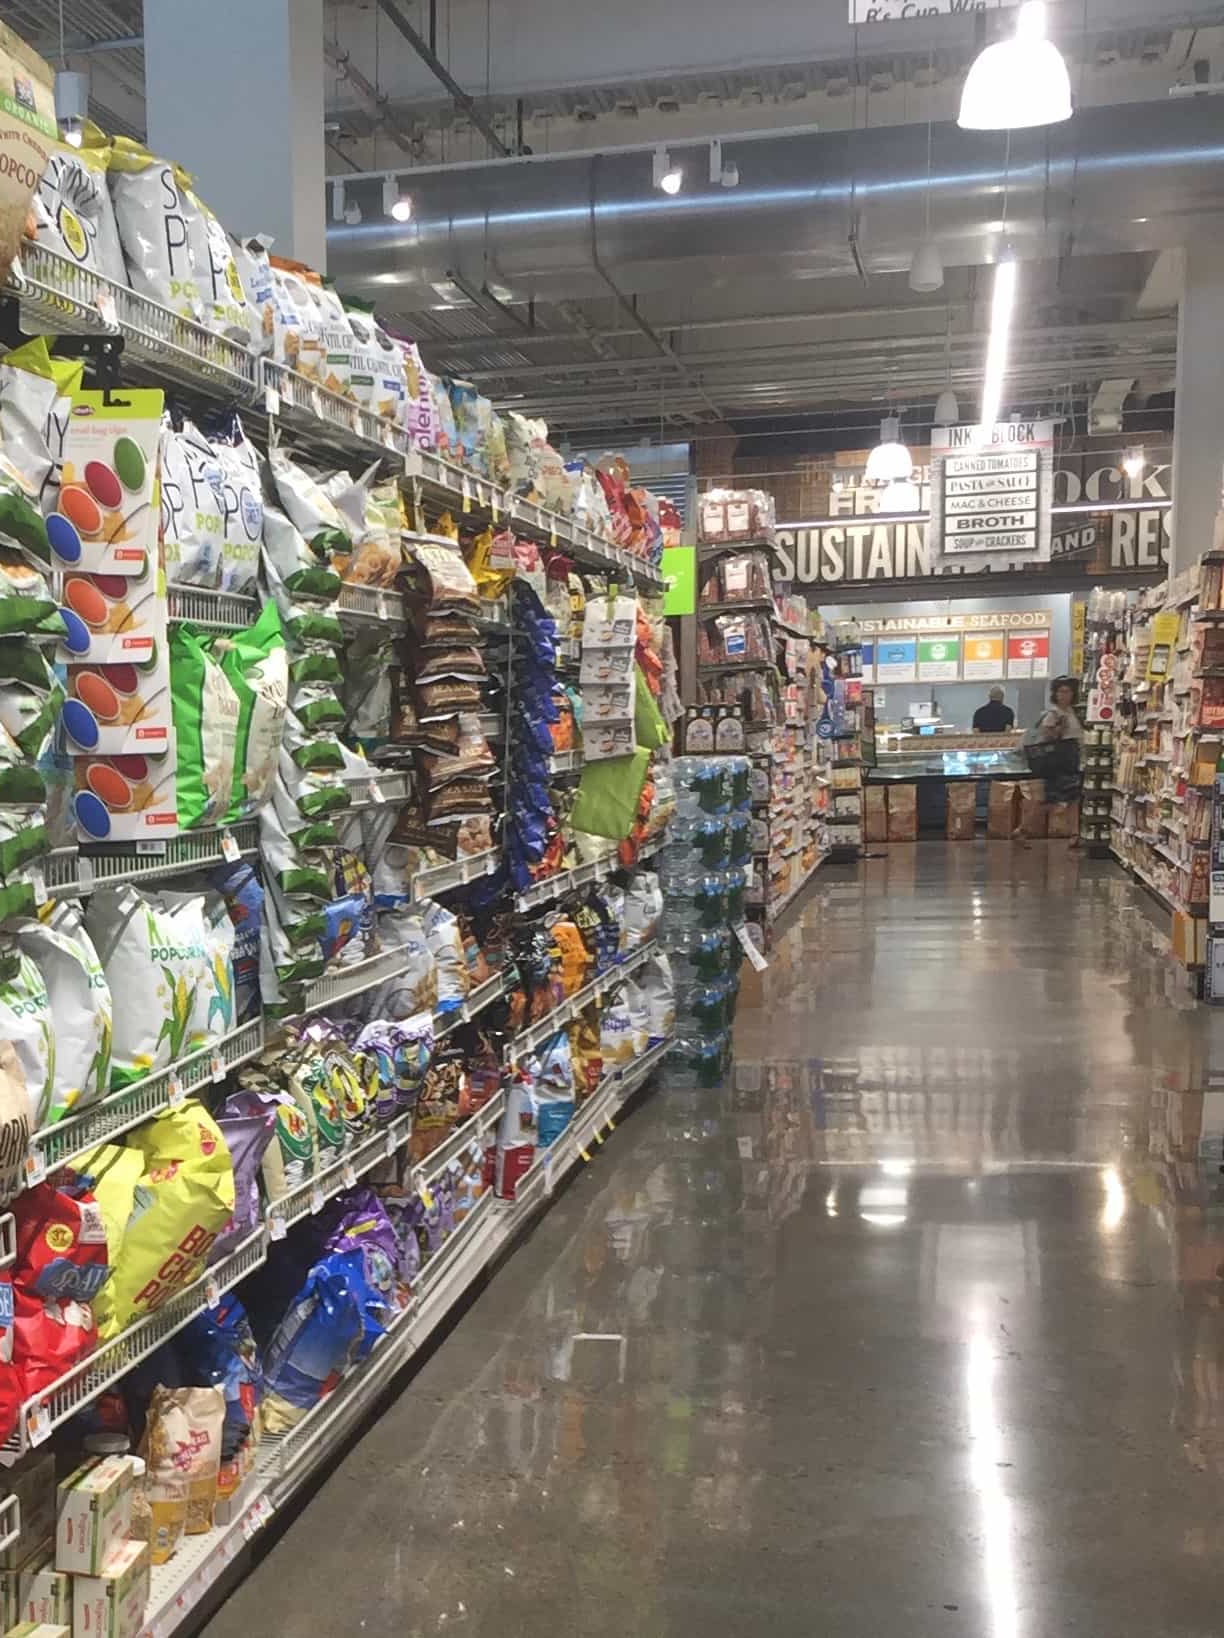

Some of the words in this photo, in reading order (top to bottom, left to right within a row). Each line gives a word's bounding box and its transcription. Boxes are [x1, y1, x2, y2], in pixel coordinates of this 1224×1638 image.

[950, 500, 976, 509] MAC
[987, 495, 1031, 508] CHEESE
[956, 515, 1025, 529] BROTH
[953, 537, 974, 549] SOUP
[772, 522, 932, 583] SUSTAIN
[1051, 527, 1096, 555] AND
[968, 612, 1047, 628] SEAFOOD
